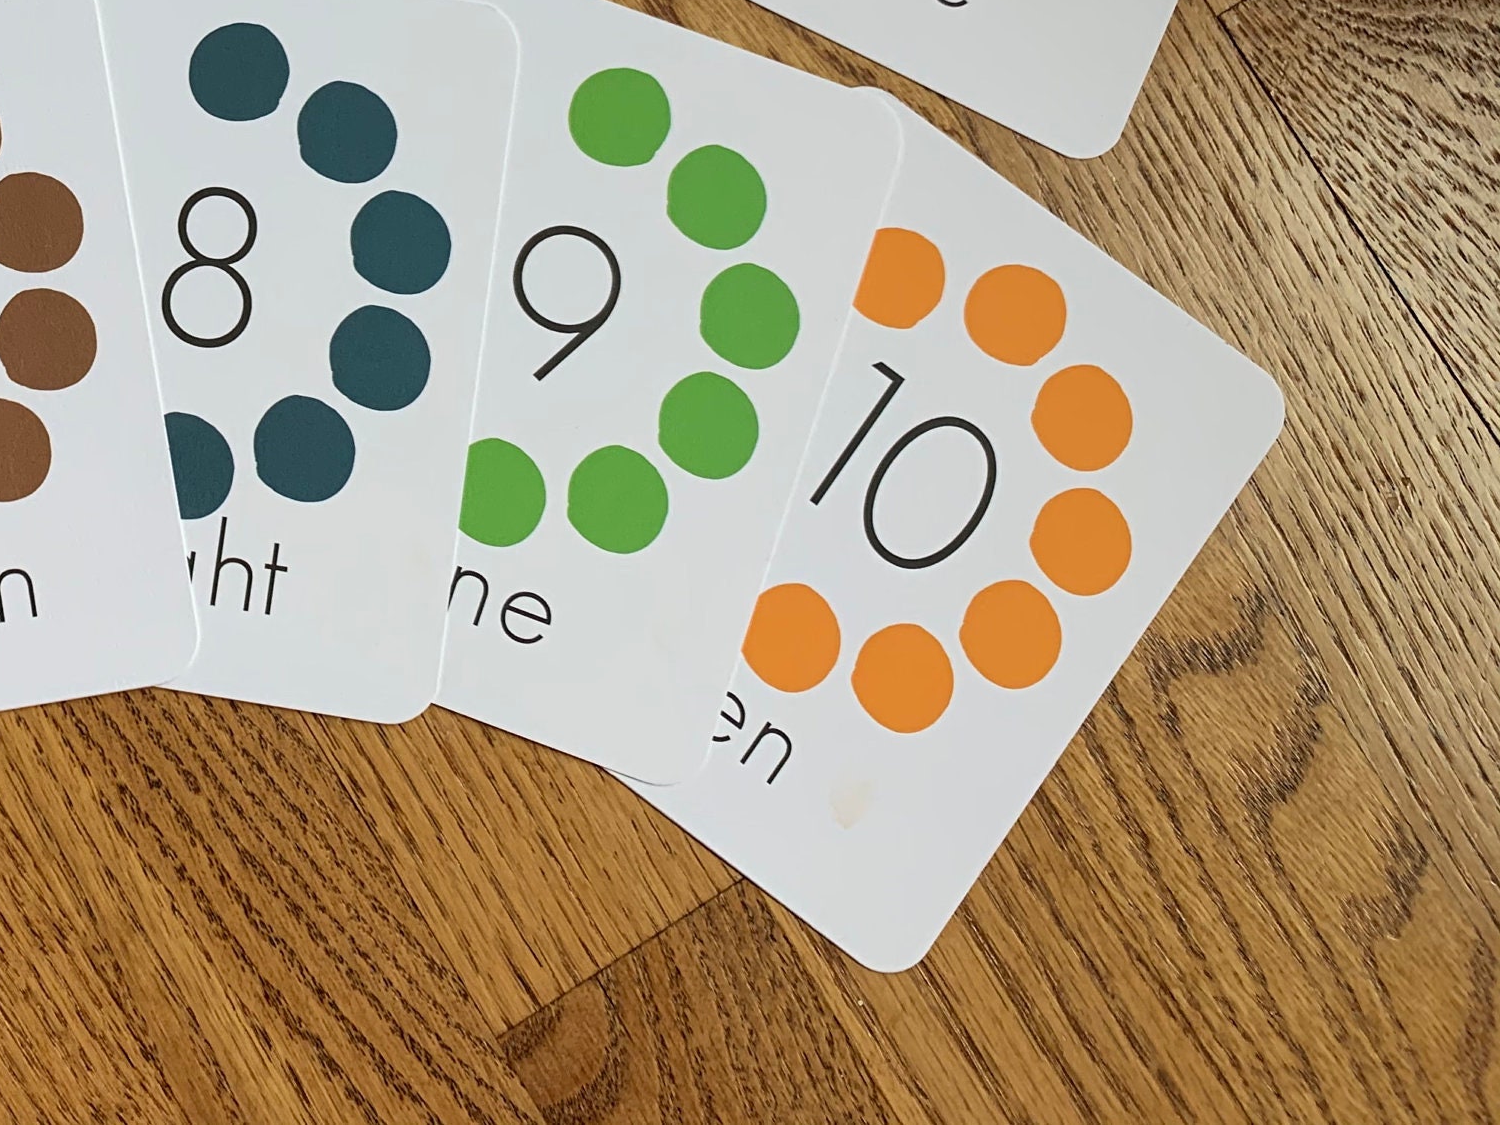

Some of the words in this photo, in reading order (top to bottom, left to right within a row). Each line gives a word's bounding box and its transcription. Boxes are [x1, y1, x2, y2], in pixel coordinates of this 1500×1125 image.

[160, 185, 259, 350] 8
[511, 224, 623, 383] 9
[808, 360, 998, 571] 10
[446, 564, 553, 646] ne
